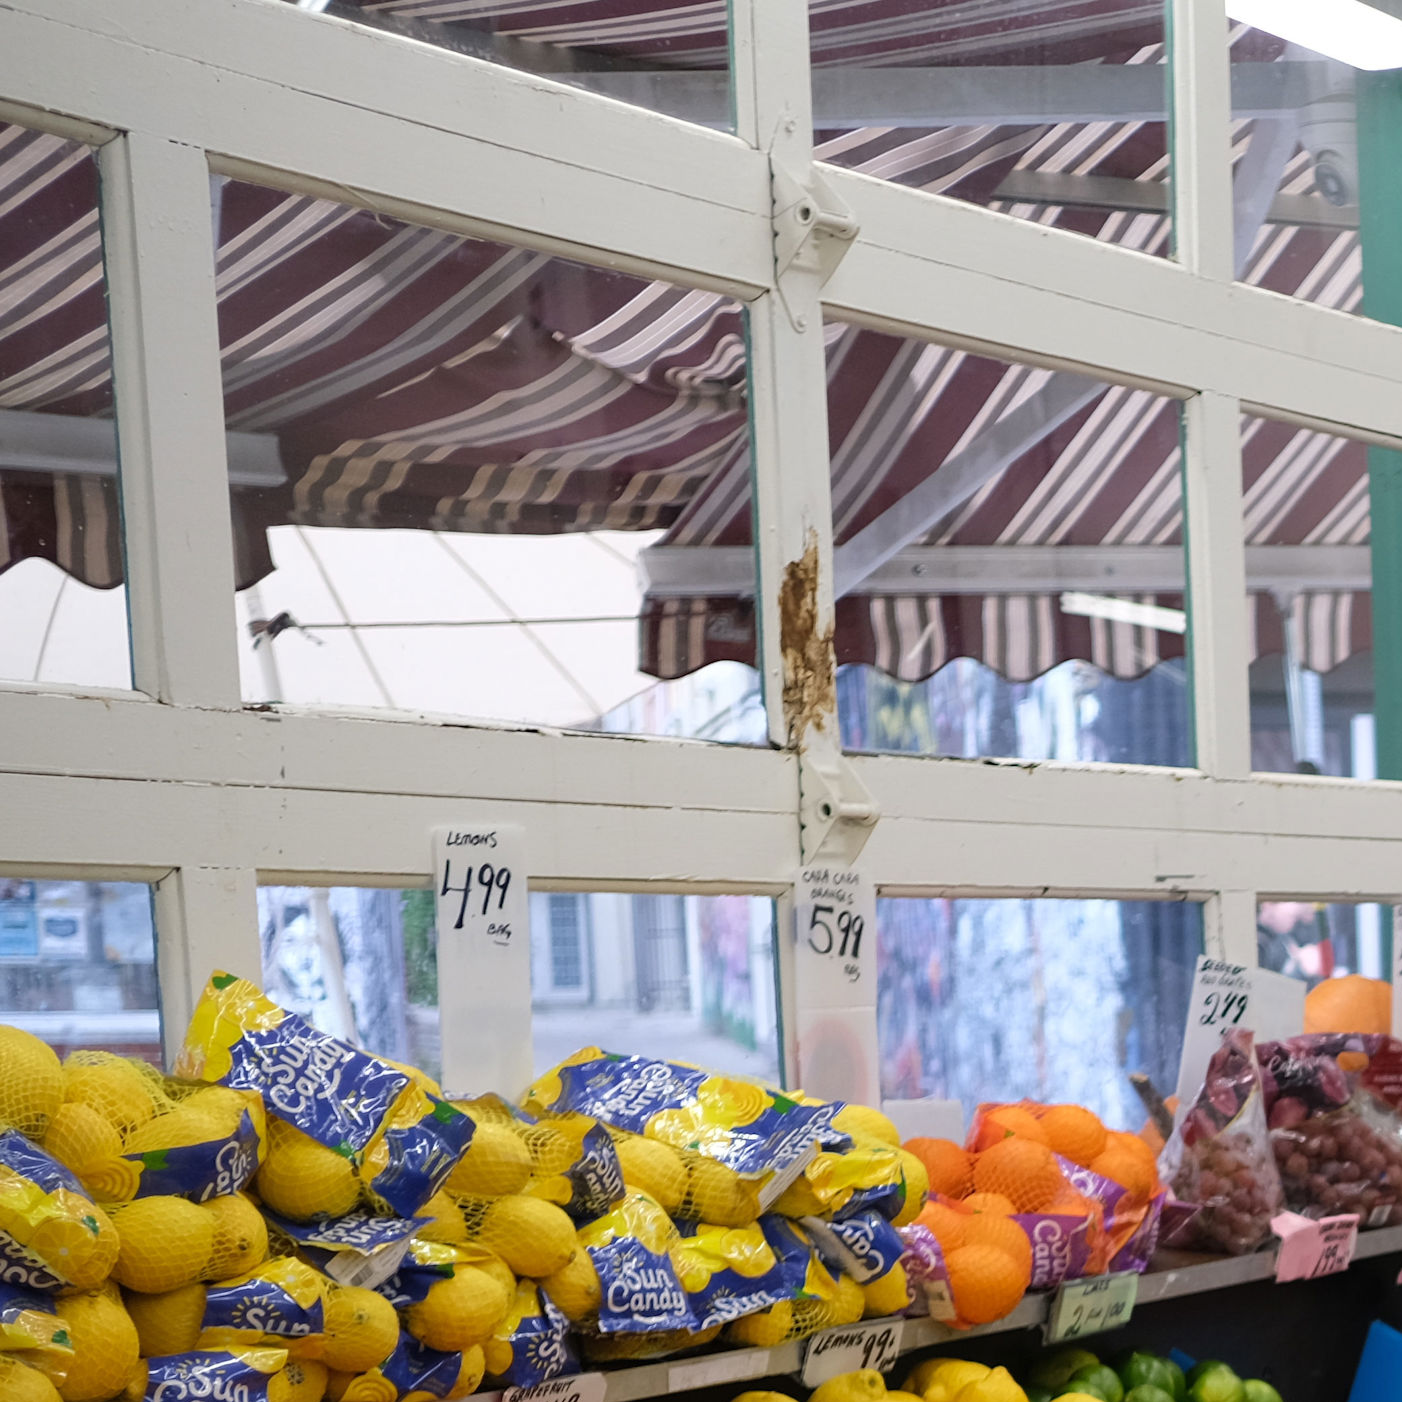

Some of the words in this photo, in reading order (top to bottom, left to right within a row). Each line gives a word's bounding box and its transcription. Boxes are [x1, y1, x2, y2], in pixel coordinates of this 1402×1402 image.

[446, 831, 498, 848] LEMONS
[623, 1257, 673, 1292] Sun
[607, 1279, 687, 1317] Candy
[813, 1330, 866, 1356] LEMONS
